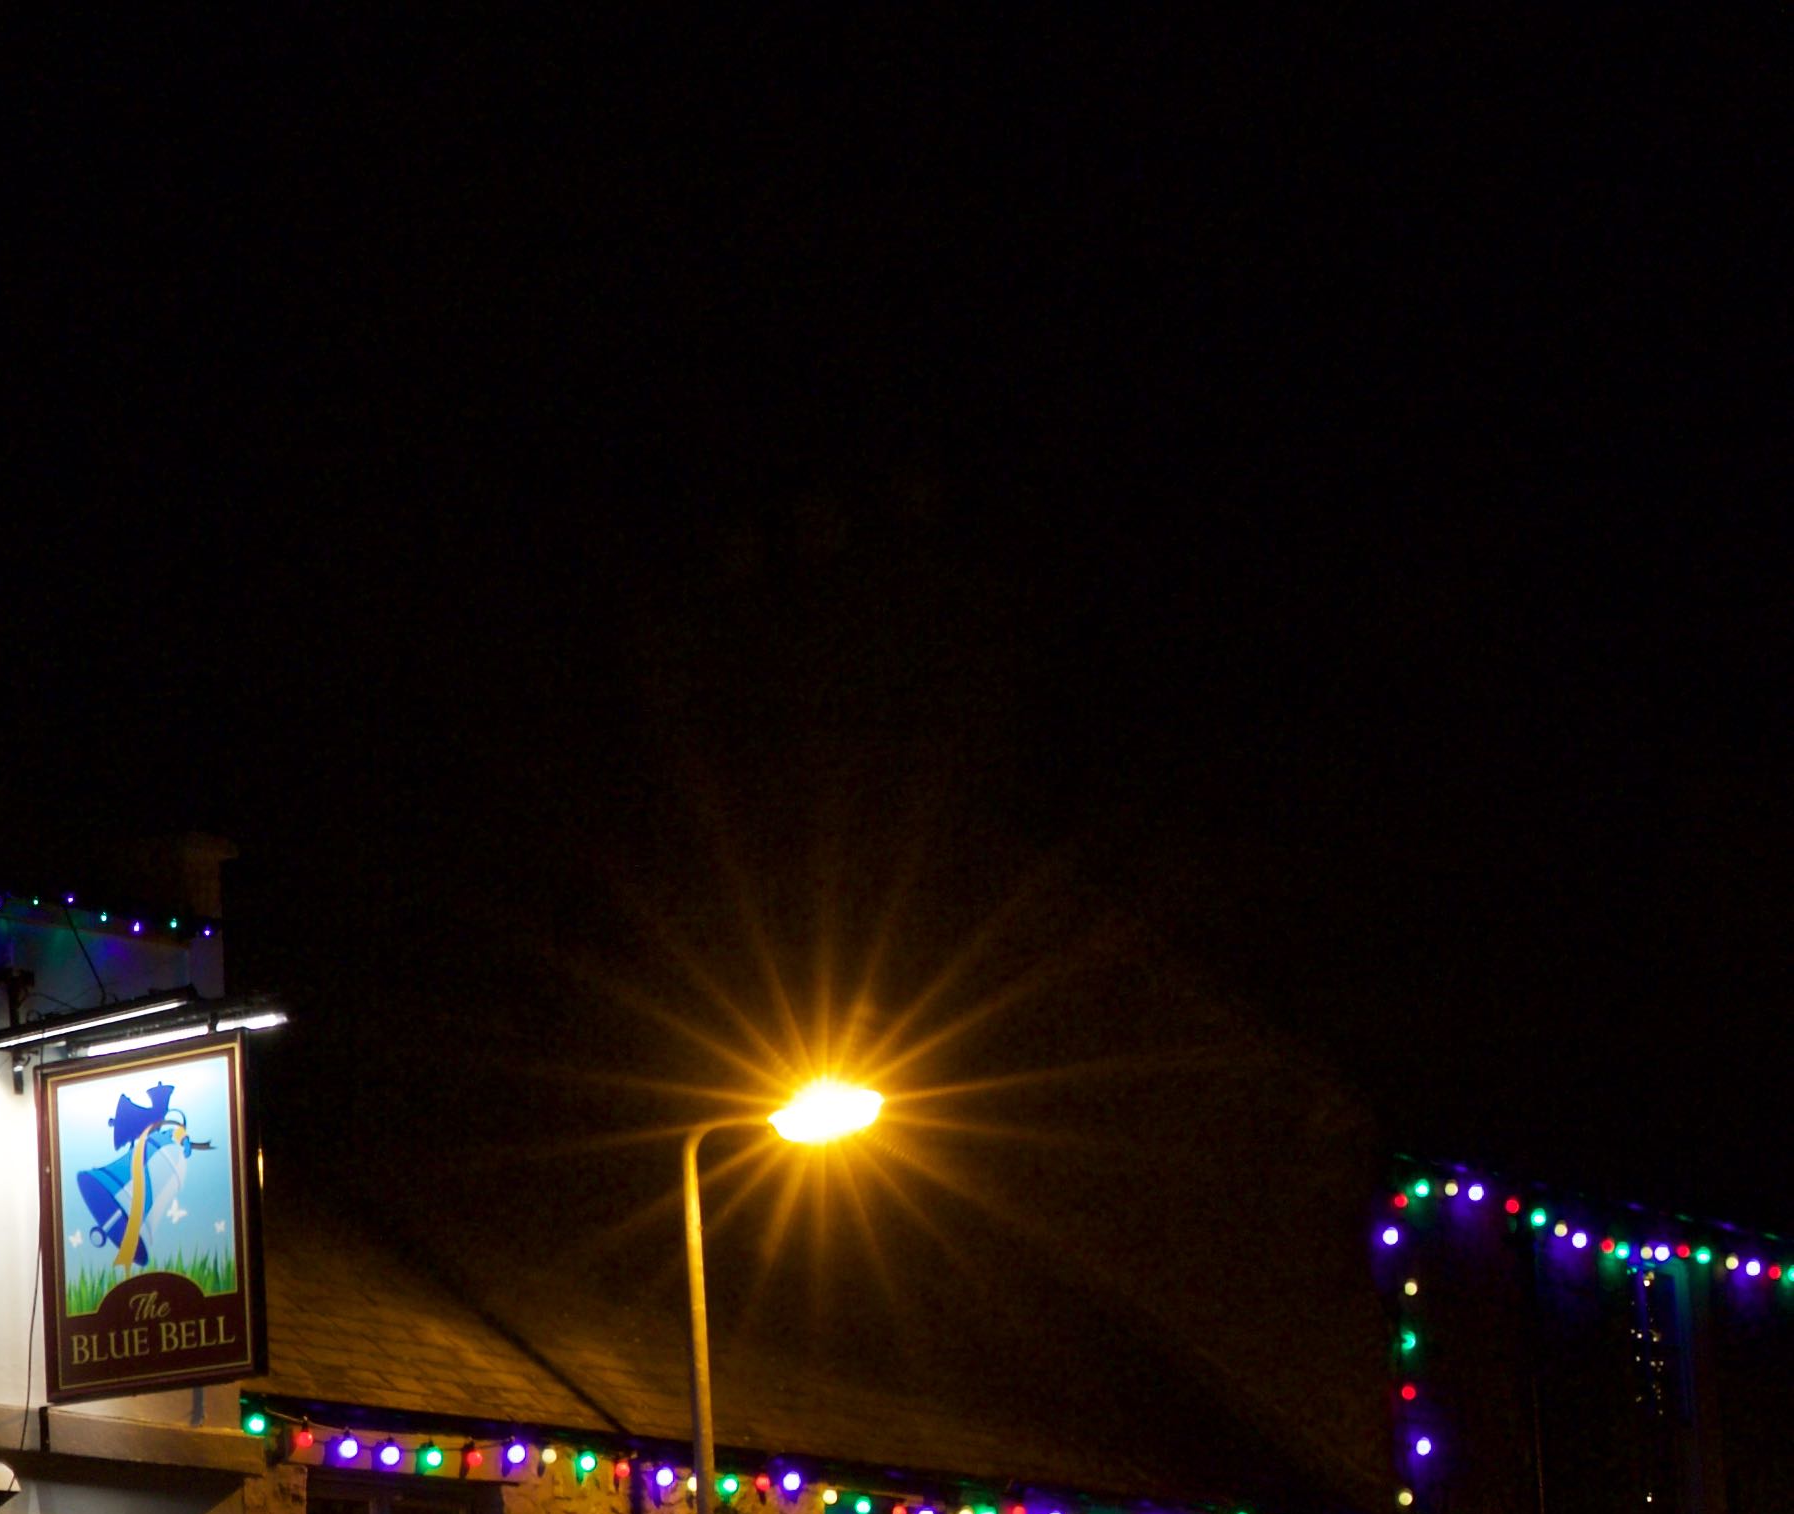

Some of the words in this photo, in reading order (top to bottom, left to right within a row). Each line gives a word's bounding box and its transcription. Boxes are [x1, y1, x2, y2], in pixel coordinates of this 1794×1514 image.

[129, 1291, 172, 1322] The
[70, 1327, 151, 1366] BLUE
[160, 1315, 236, 1354] BELL
